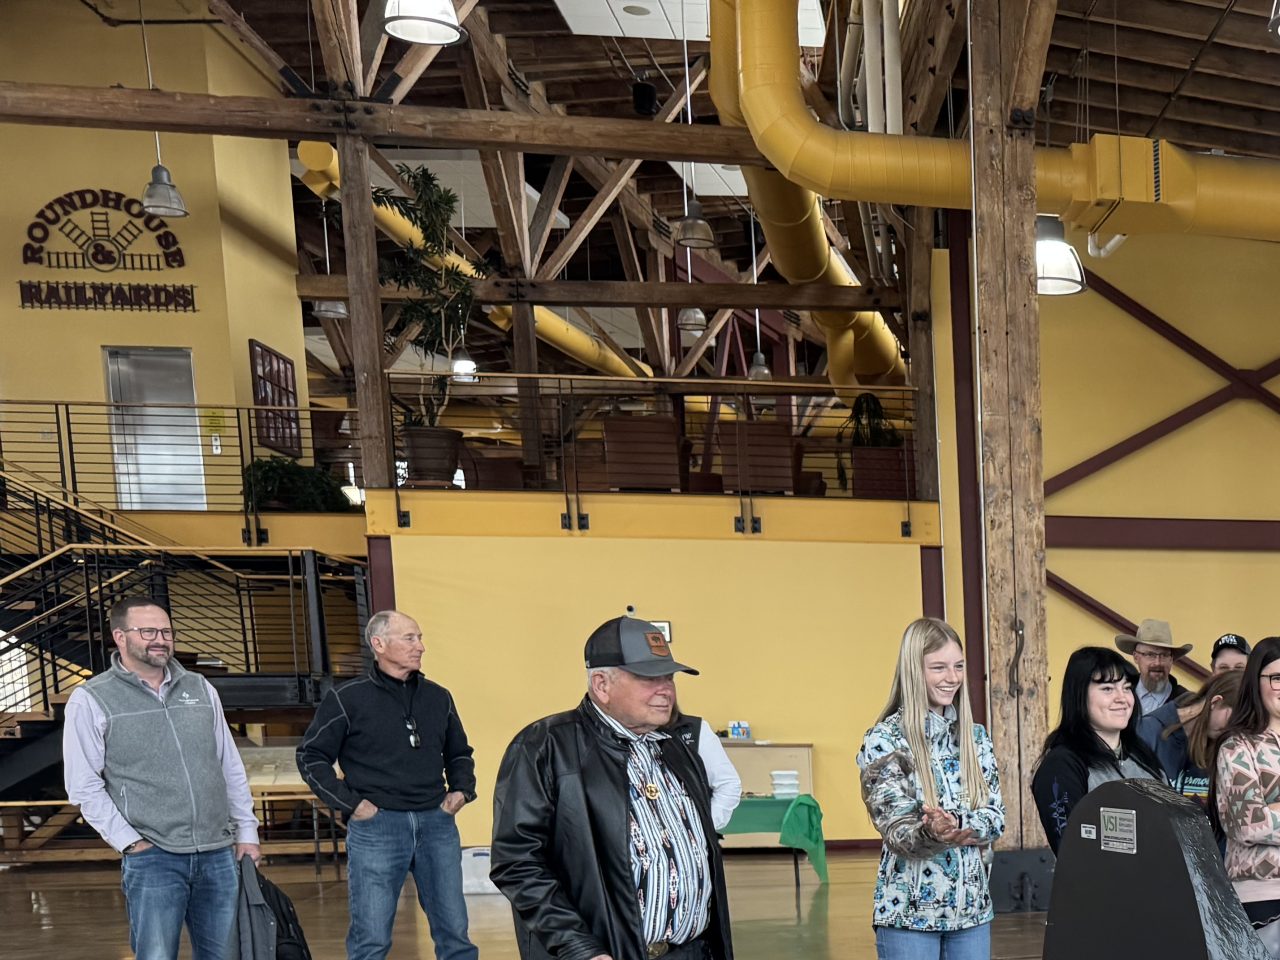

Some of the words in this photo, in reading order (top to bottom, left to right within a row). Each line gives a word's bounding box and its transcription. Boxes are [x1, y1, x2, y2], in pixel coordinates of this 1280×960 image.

[23, 188, 186, 269] ROUNDHOUSE
[20, 283, 194, 309] RAILYARDS
[1103, 815, 1118, 832] VSI
